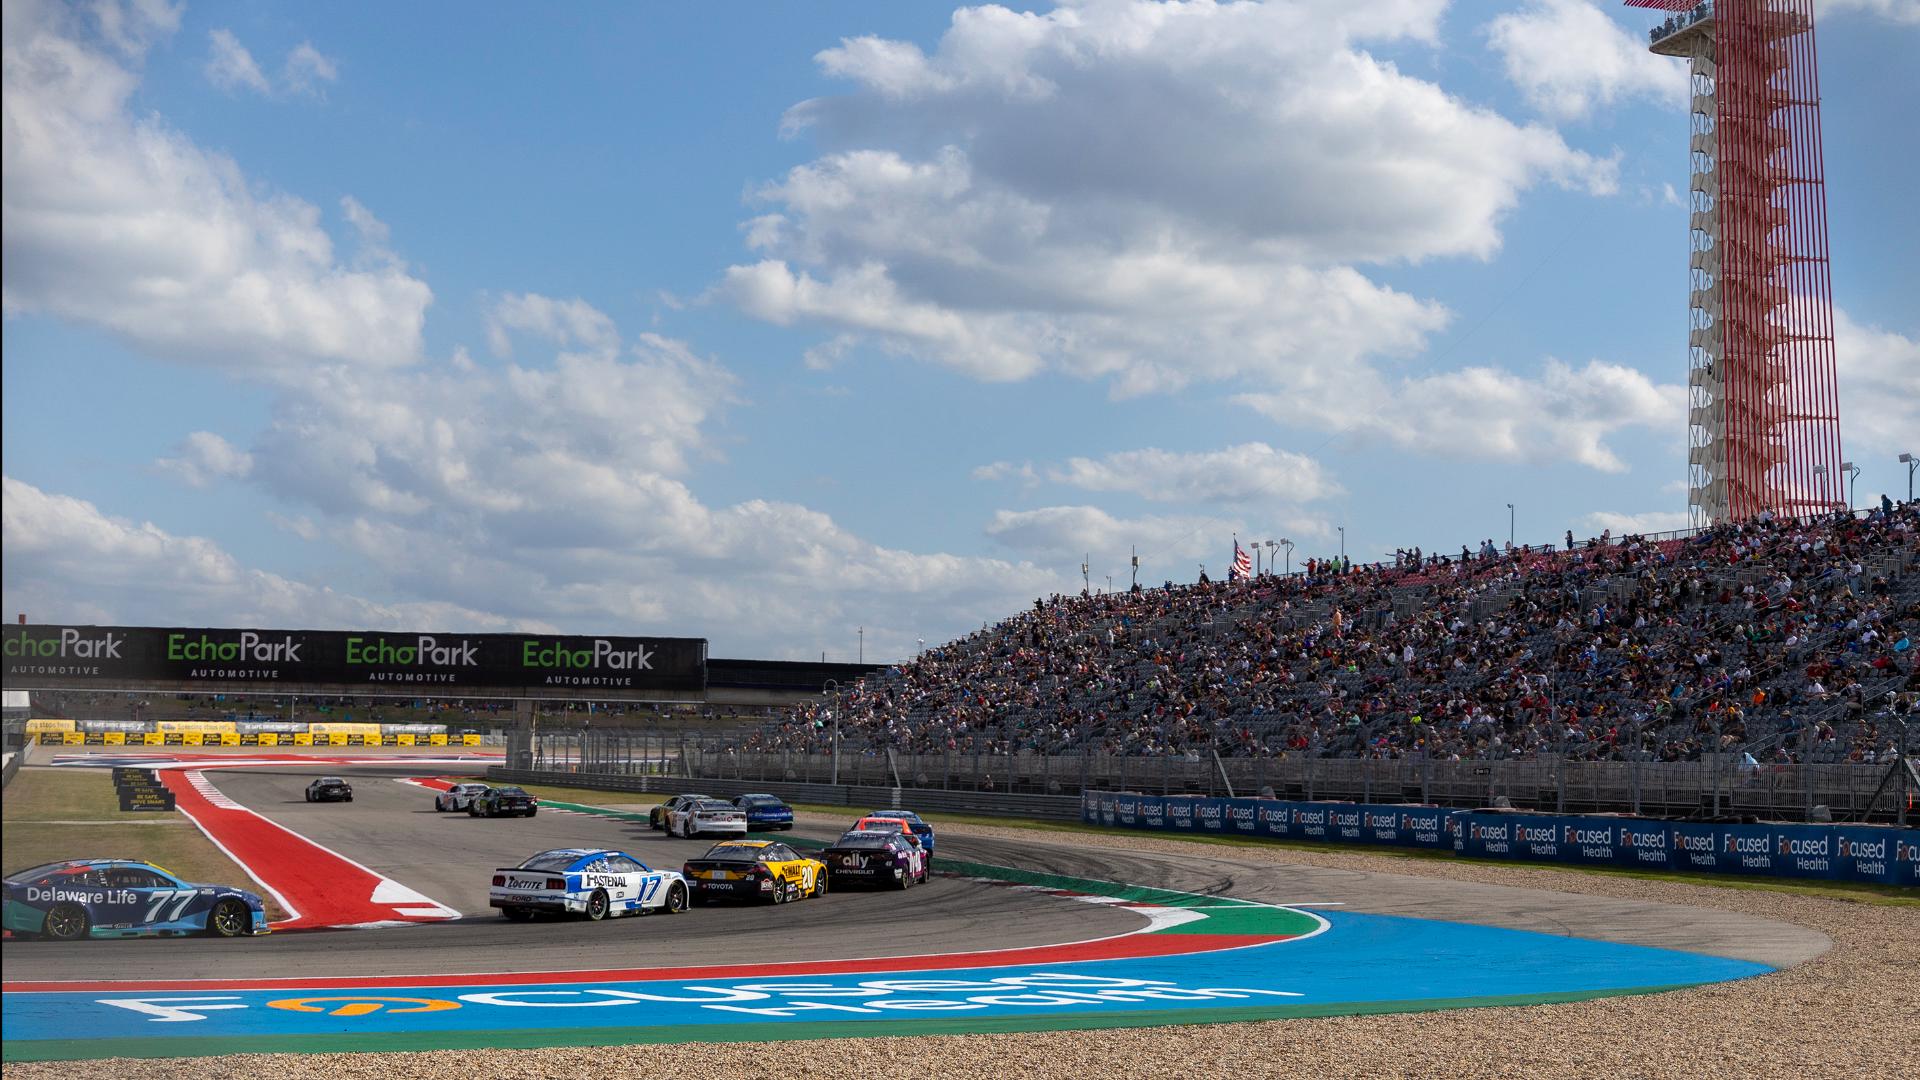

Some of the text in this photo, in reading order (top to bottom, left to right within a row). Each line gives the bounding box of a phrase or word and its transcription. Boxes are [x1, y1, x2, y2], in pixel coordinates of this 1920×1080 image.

[2, 628, 122, 659] choPark
[168, 632, 302, 662] EchoPark
[346, 636, 479, 666] EchoPark
[523, 640, 655, 670] EchoPark
[11, 666, 100, 675] AUTOMOTIVE
[191, 669, 279, 678] AUTOMOTIVE
[369, 673, 455, 682] AUTOMOTIVE
[546, 676, 631, 686] AUTOMOTIVE
[1166, 803, 1191, 817] Focused
[1195, 804, 1221, 818] Focused
[1225, 804, 1254, 819] Focused
[1258, 807, 1288, 822] Focused
[1291, 808, 1324, 824] Focused
[1176, 818, 1192, 827] Health
[1205, 820, 1221, 829] Health
[1237, 820, 1255, 830] Health
[1328, 810, 1359, 826] Focused
[1364, 811, 1396, 828] Focused
[1401, 813, 1438, 830] Focused
[1269, 822, 1288, 833] Health
[1305, 825, 1325, 836] Health
[1341, 826, 1360, 838] Health
[1376, 828, 1396, 840] Health
[1470, 822, 1508, 840] Focused
[1516, 824, 1556, 842] Focused
[1564, 825, 1611, 844] Focused
[1416, 831, 1438, 843] Health
[1620, 828, 1665, 848] Focused
[1673, 831, 1714, 851] Focused
[1724, 833, 1769, 853] Focused
[1486, 841, 1508, 853] Health
[1531, 843, 1557, 855] Health
[1583, 846, 1613, 858] Health
[1778, 835, 1828, 855] Focused
[1837, 836, 1886, 859] Focused
[843, 853, 869, 868] ally
[1638, 849, 1666, 862] Health
[1691, 852, 1716, 866] Health
[1743, 855, 1771, 868] Health
[1797, 857, 1829, 871] Health
[1857, 860, 1885, 875] Health
[507, 880, 543, 889] LOCTITE
[586, 874, 628, 888] FASTENAL
[802, 865, 814, 890] 20
[27, 886, 136, 904] Delaware Life
[636, 875, 663, 903] 17
[145, 890, 198, 923] 77
